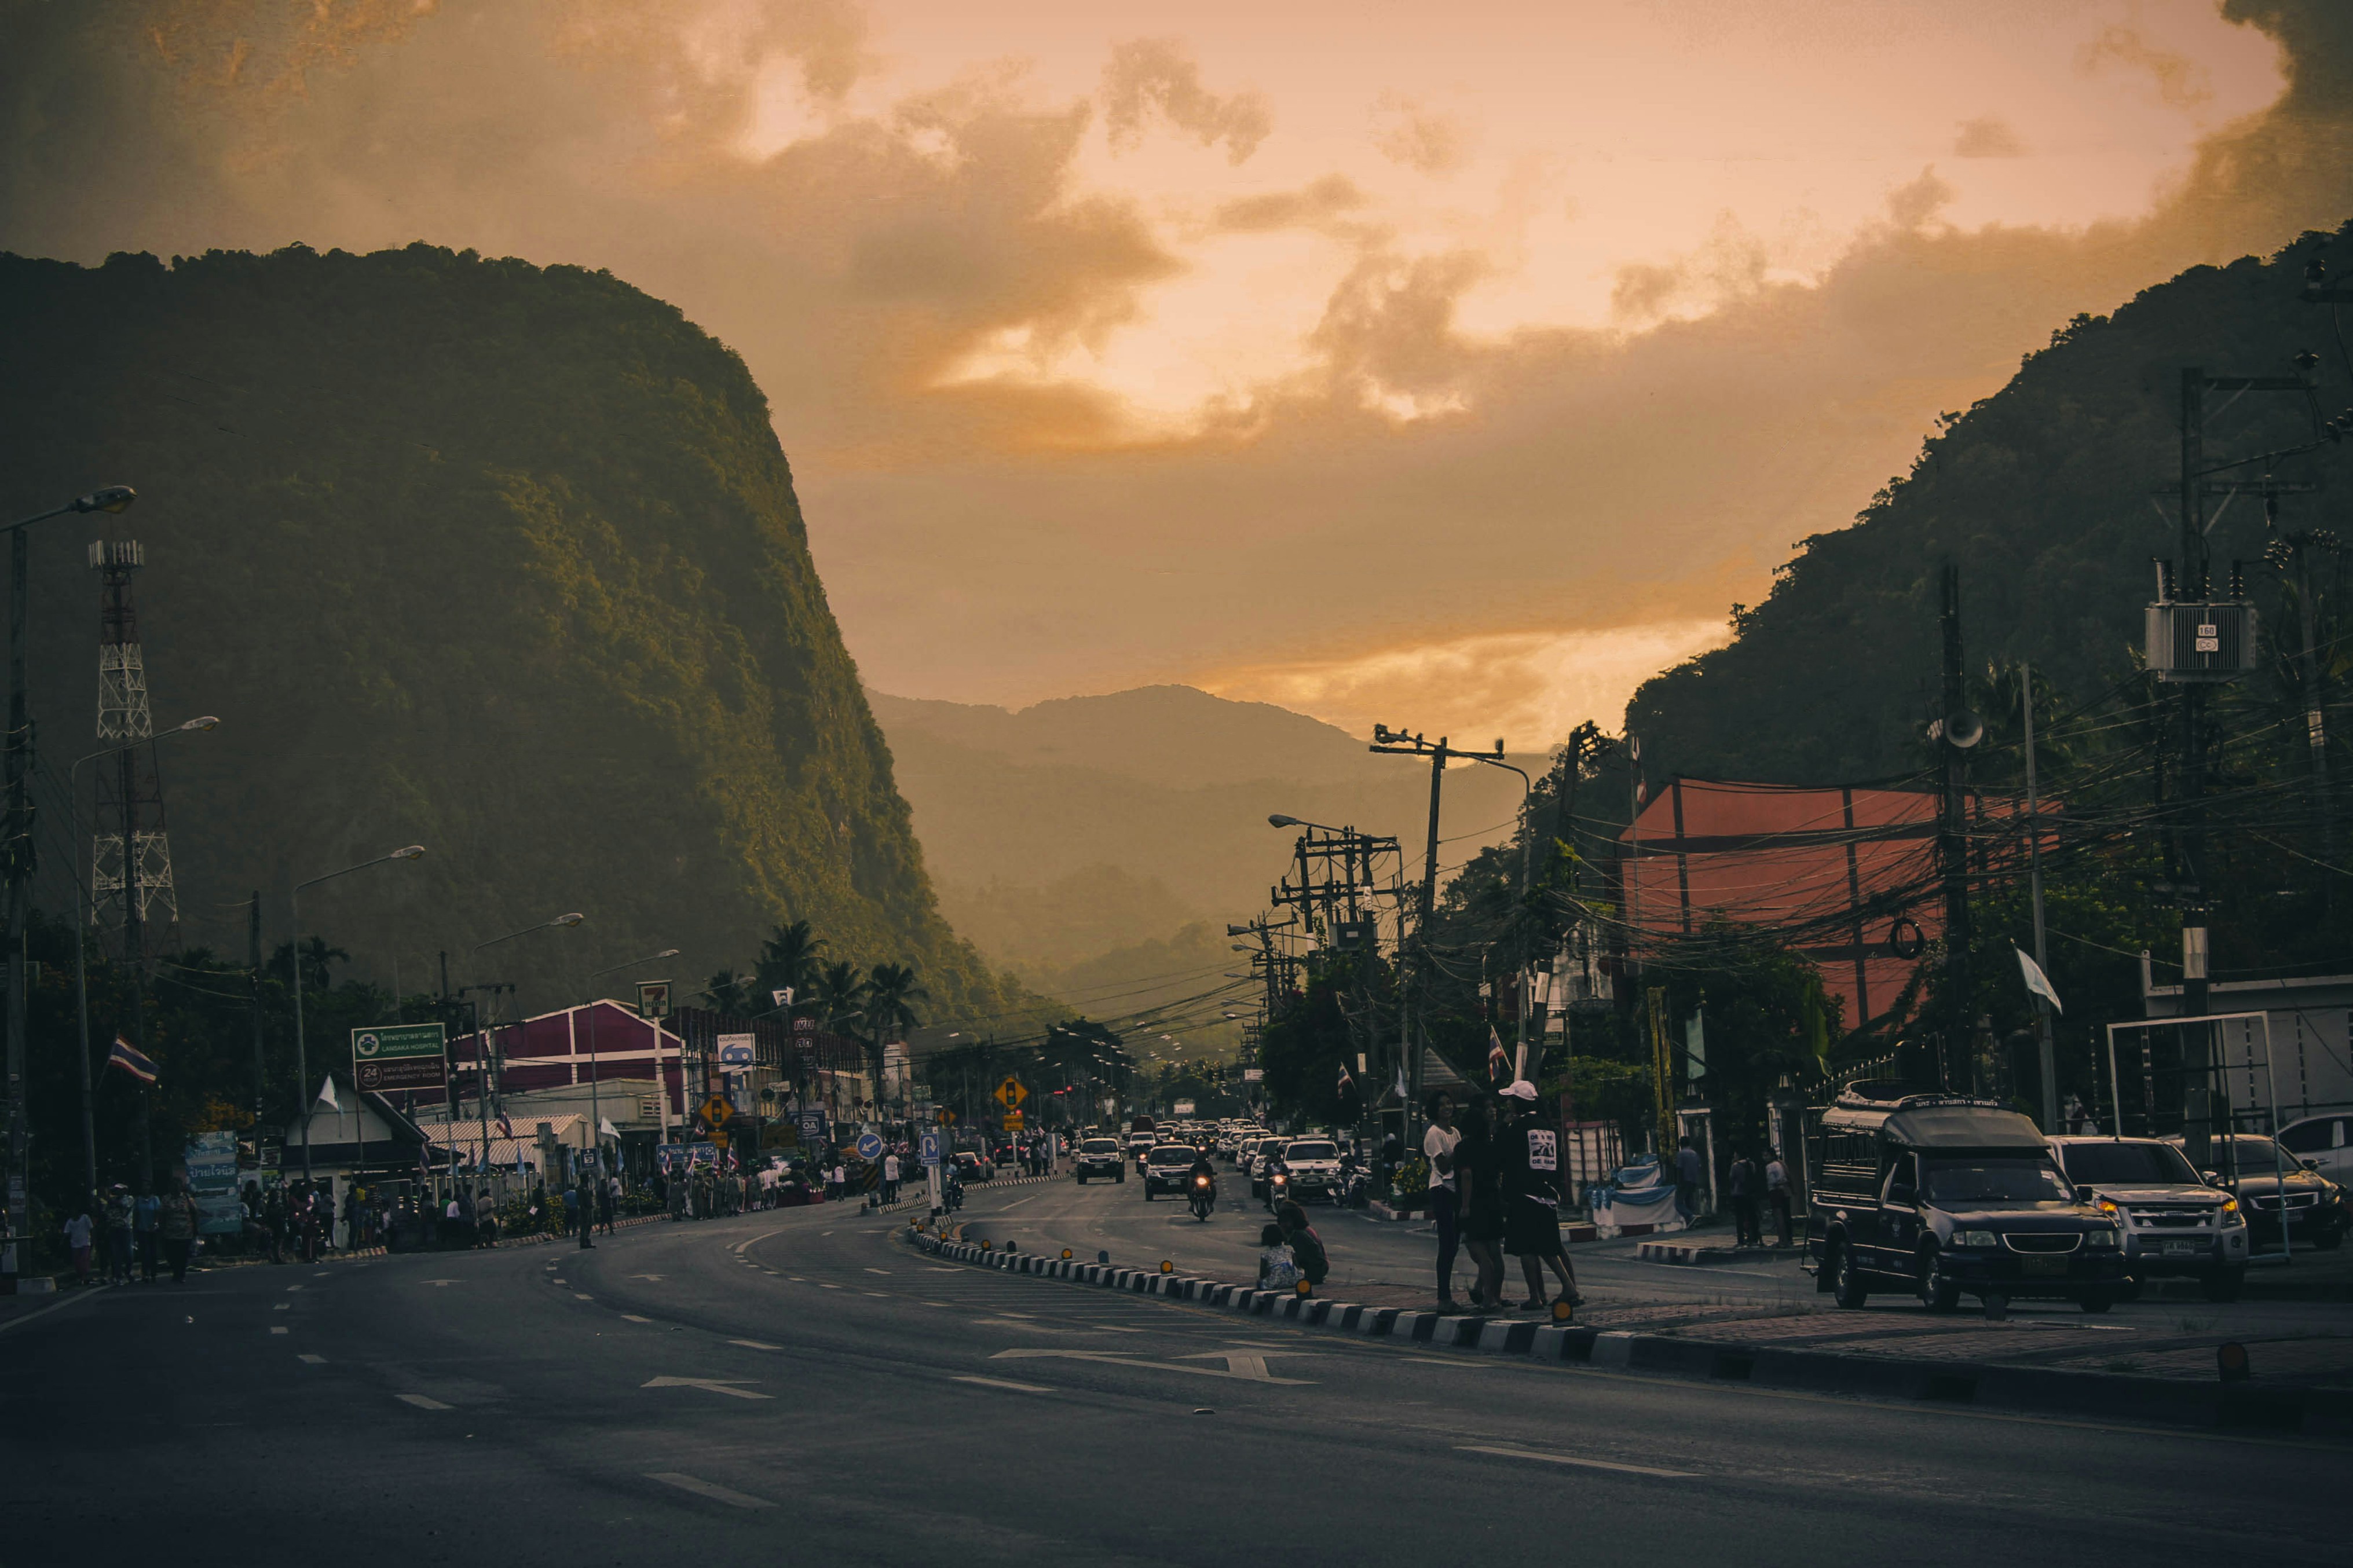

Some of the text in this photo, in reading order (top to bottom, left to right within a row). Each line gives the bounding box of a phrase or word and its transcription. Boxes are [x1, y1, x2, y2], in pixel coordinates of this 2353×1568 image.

[364, 1068, 377, 1078] 24
[189, 1164, 236, 1178] ป้ายไวนิล
